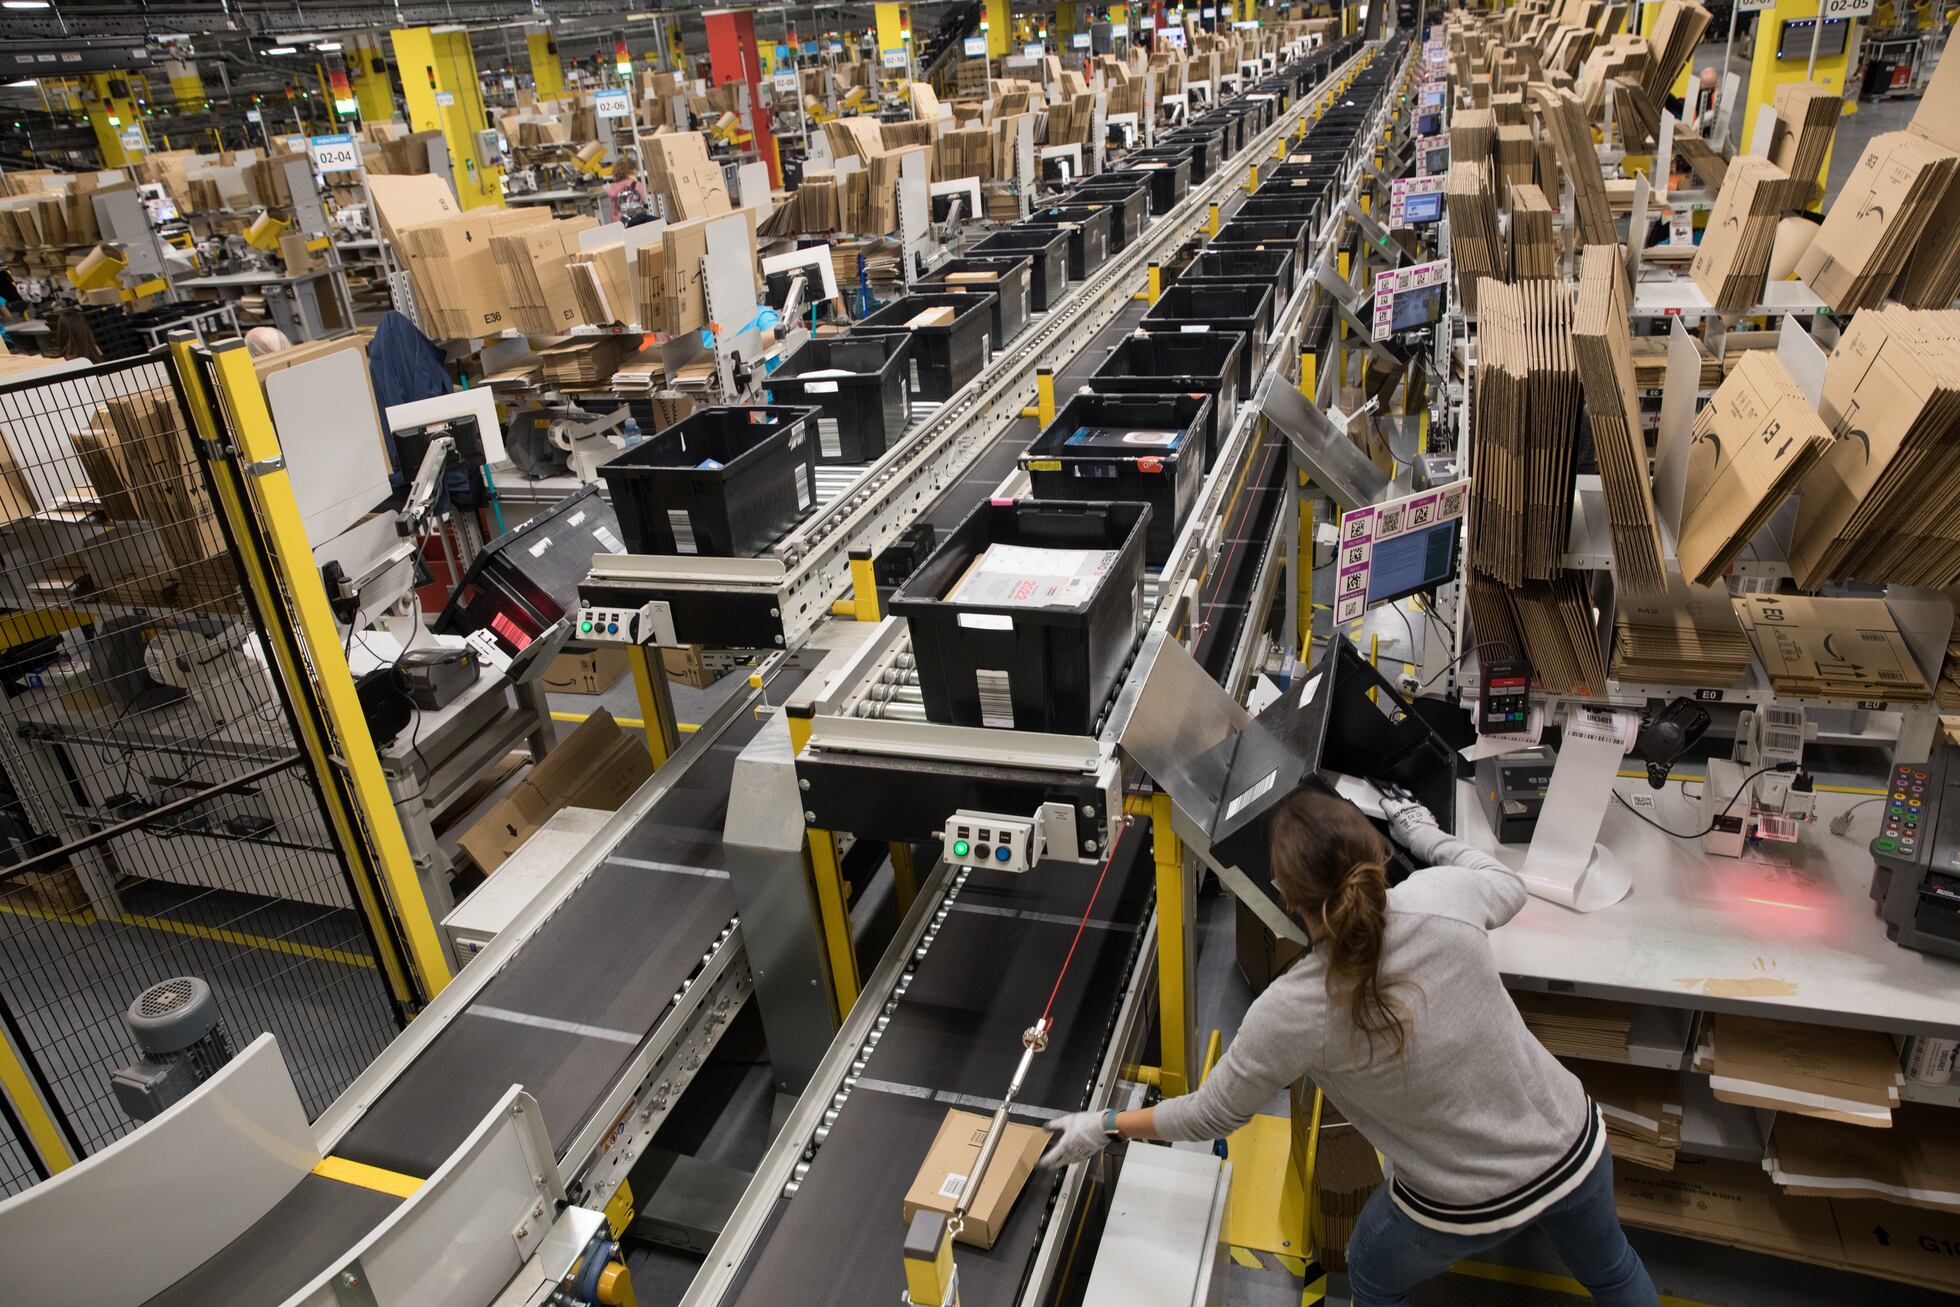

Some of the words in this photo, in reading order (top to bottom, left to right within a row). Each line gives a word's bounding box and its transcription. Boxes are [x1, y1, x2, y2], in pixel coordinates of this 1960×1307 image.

[1830, 0, 1868, 11] 02-05
[600, 101, 626, 111] 02-06
[320, 151, 351, 163] 02-04
[484, 312, 502, 324] E36
[563, 309, 575, 320] E3
[1762, 608, 1785, 621] E0
[1702, 690, 1717, 699] E0
